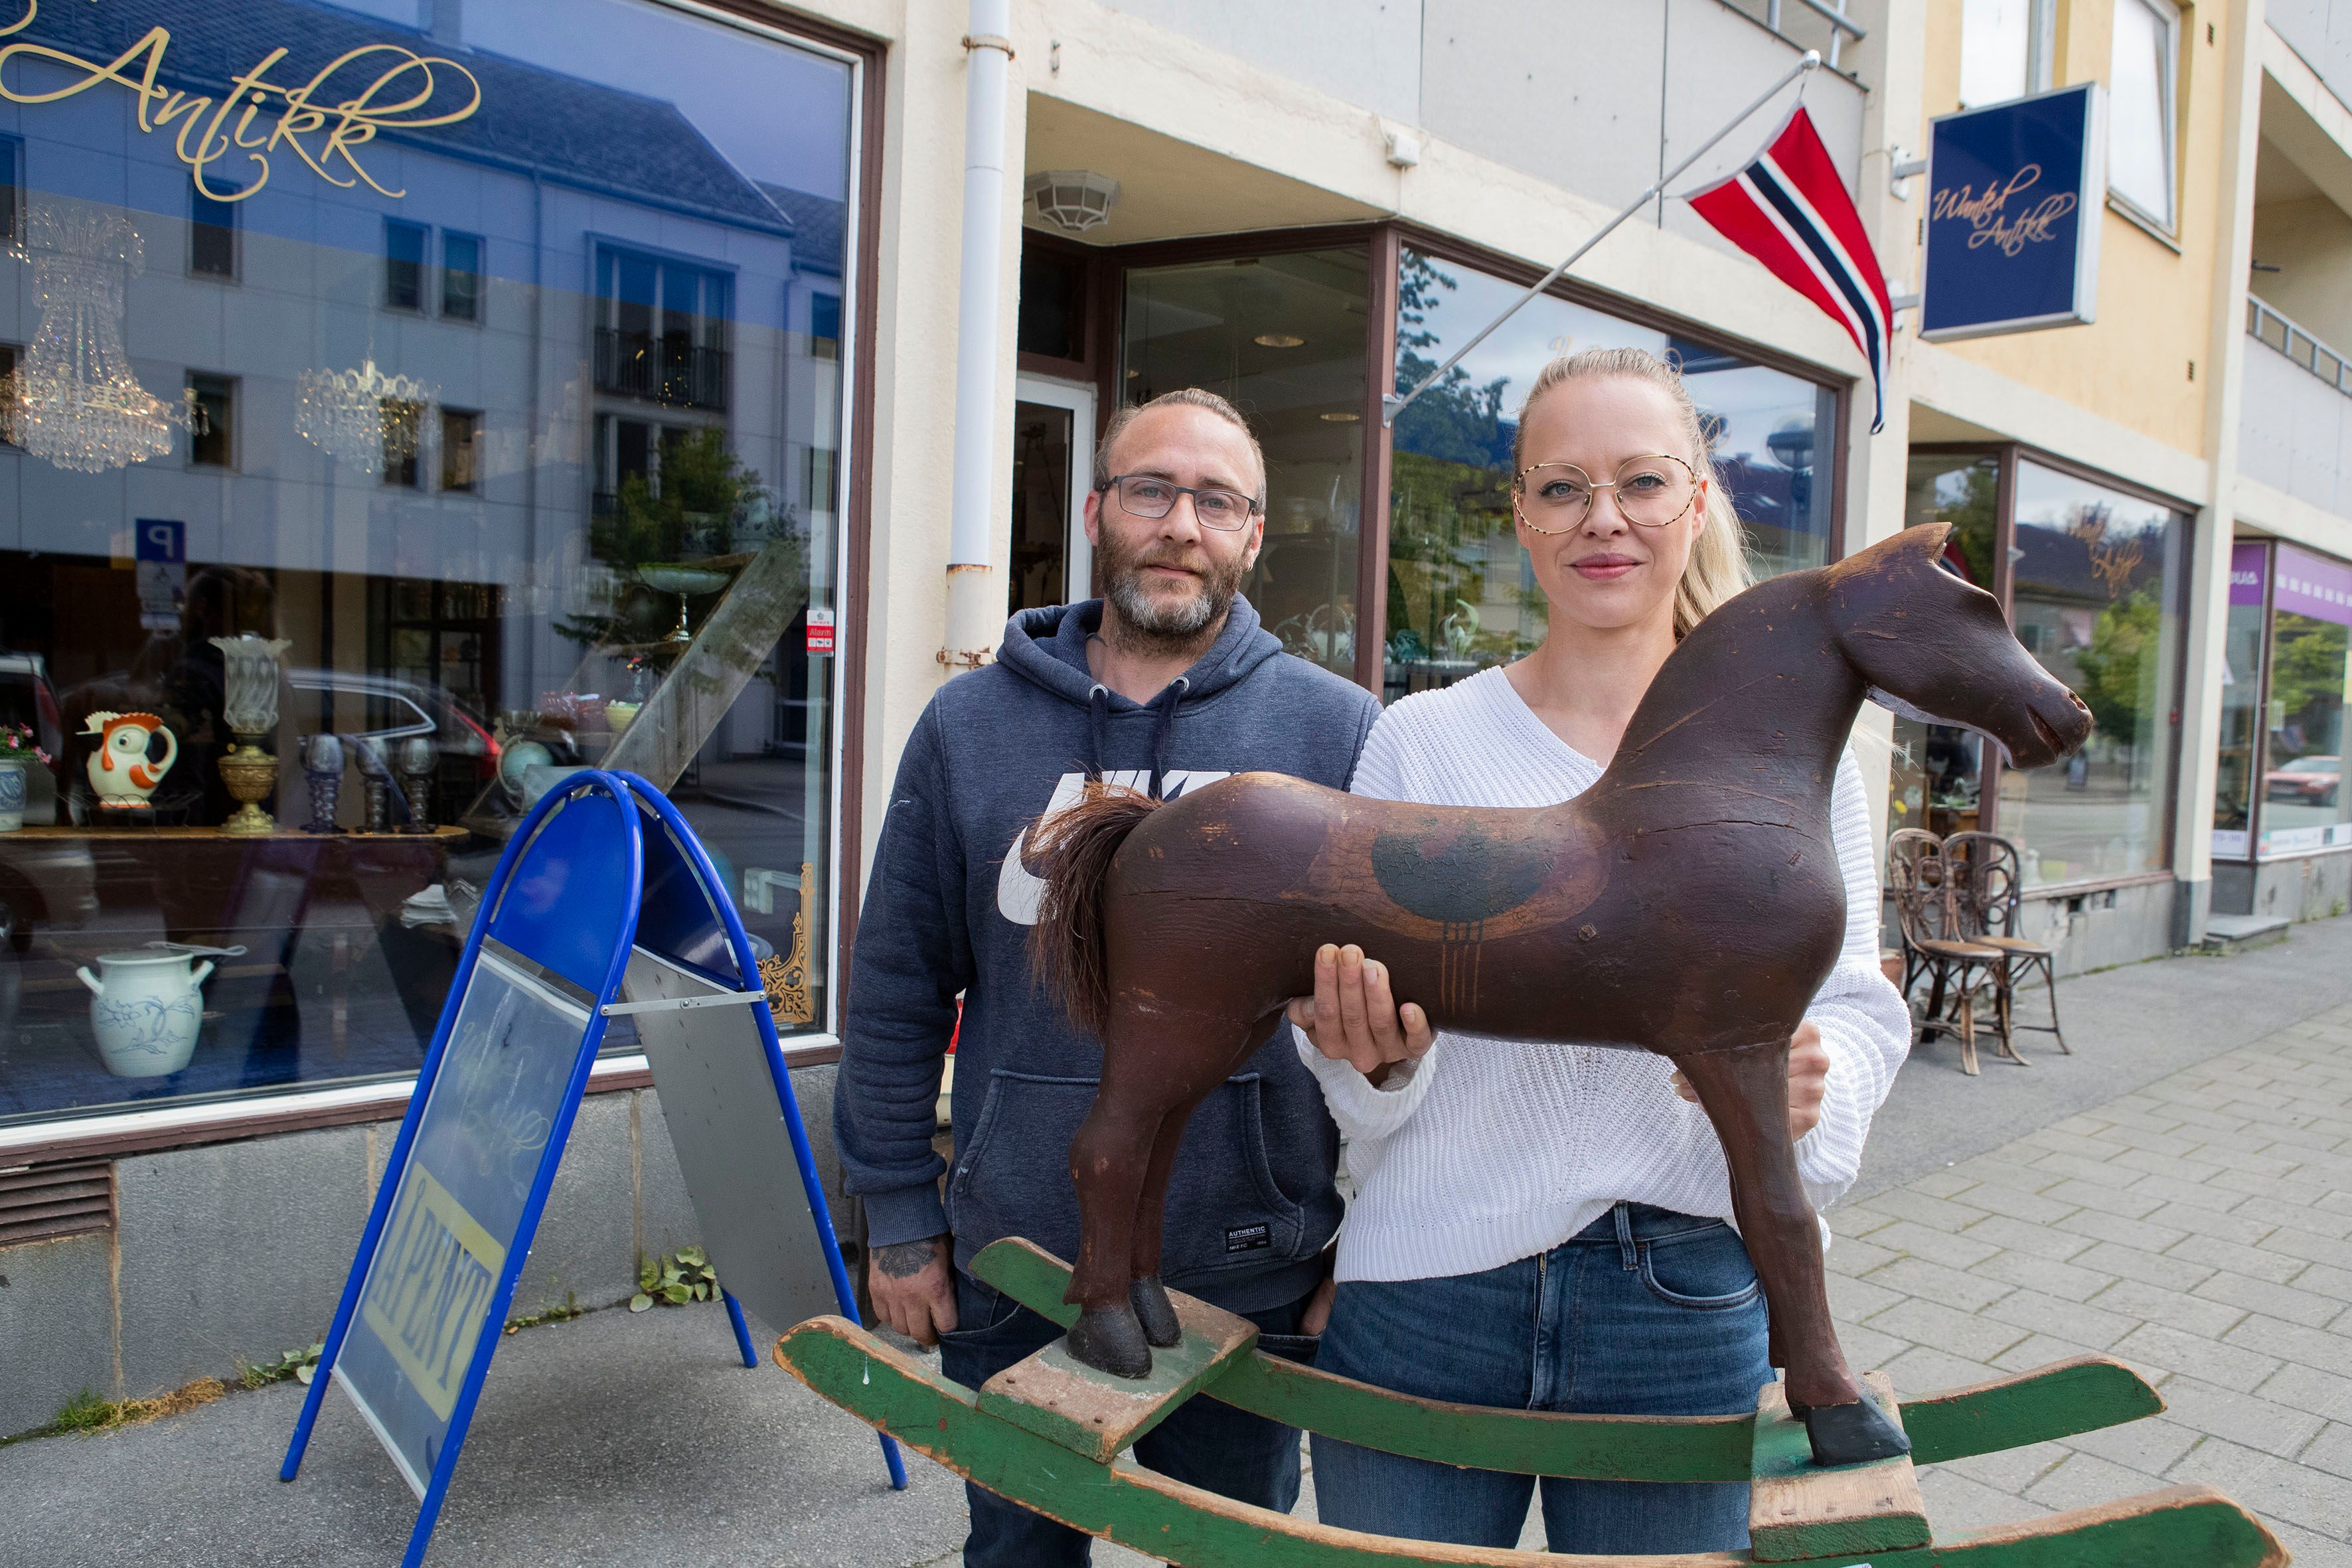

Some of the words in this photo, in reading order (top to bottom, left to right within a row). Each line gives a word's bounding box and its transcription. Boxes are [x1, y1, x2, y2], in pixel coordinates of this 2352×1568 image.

[0, 26, 481, 202] Antikk
[1932, 163, 2041, 229] Wanted
[1968, 191, 2077, 257] Antikk
[809, 627, 831, 637] Alarm
[1229, 1225, 1265, 1237] AUTHENTIC
